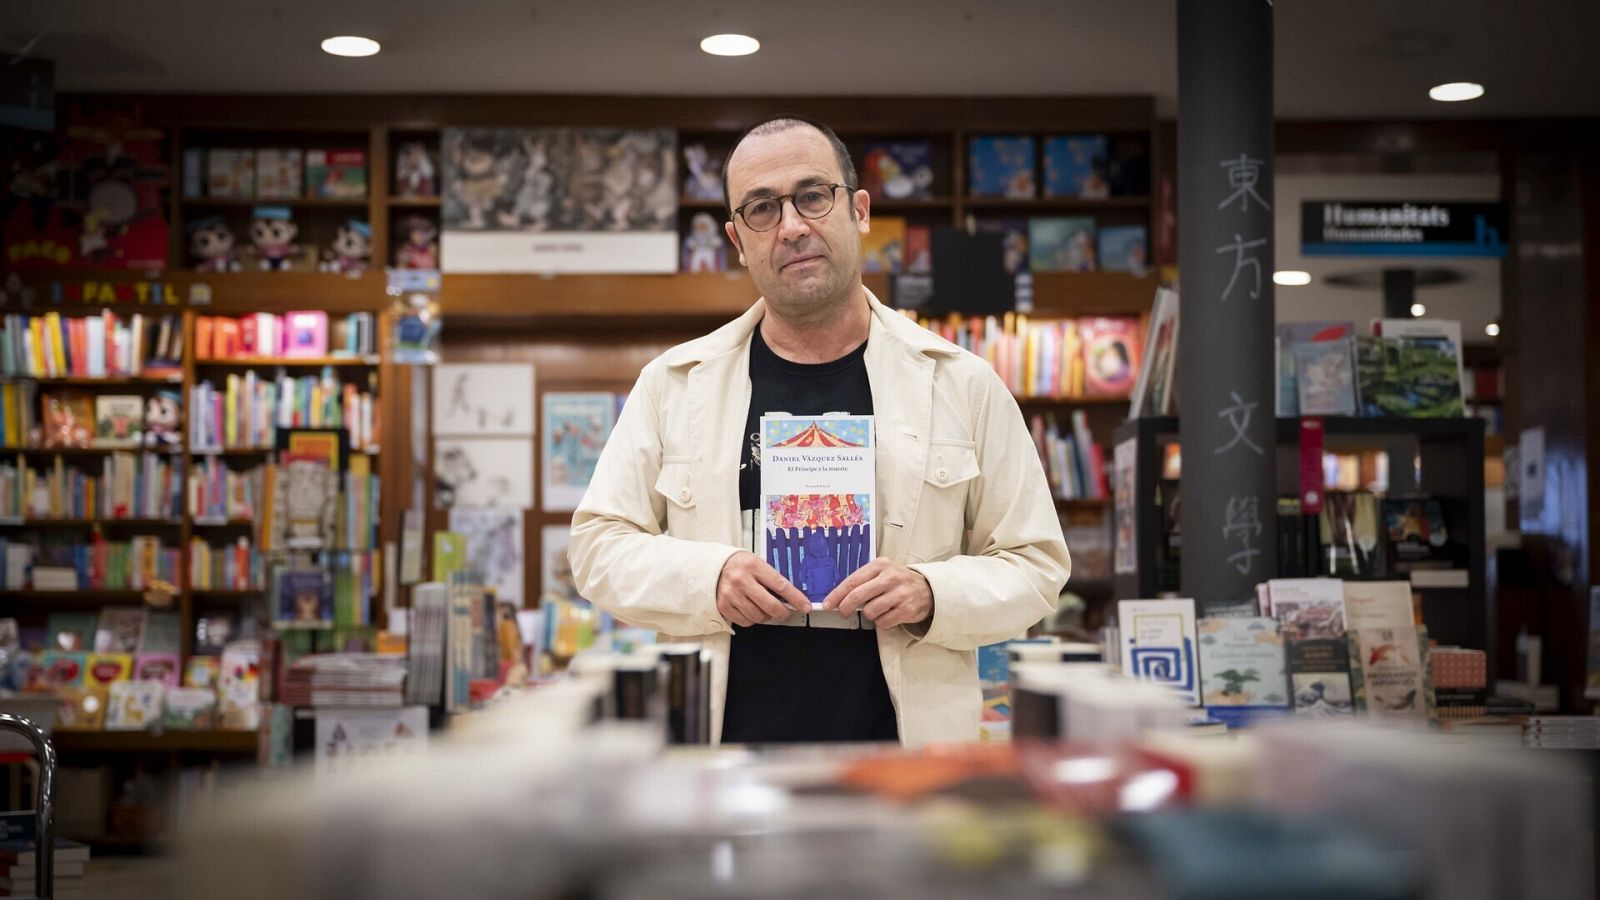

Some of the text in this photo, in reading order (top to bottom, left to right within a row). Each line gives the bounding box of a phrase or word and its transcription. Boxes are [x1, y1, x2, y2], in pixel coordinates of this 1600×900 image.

[1323, 203, 1451, 227] Humanitats
[1323, 226, 1425, 243] Humanidades
[802, 454, 835, 463] VÁZQUEZ
[836, 454, 864, 462] SALLÉS
